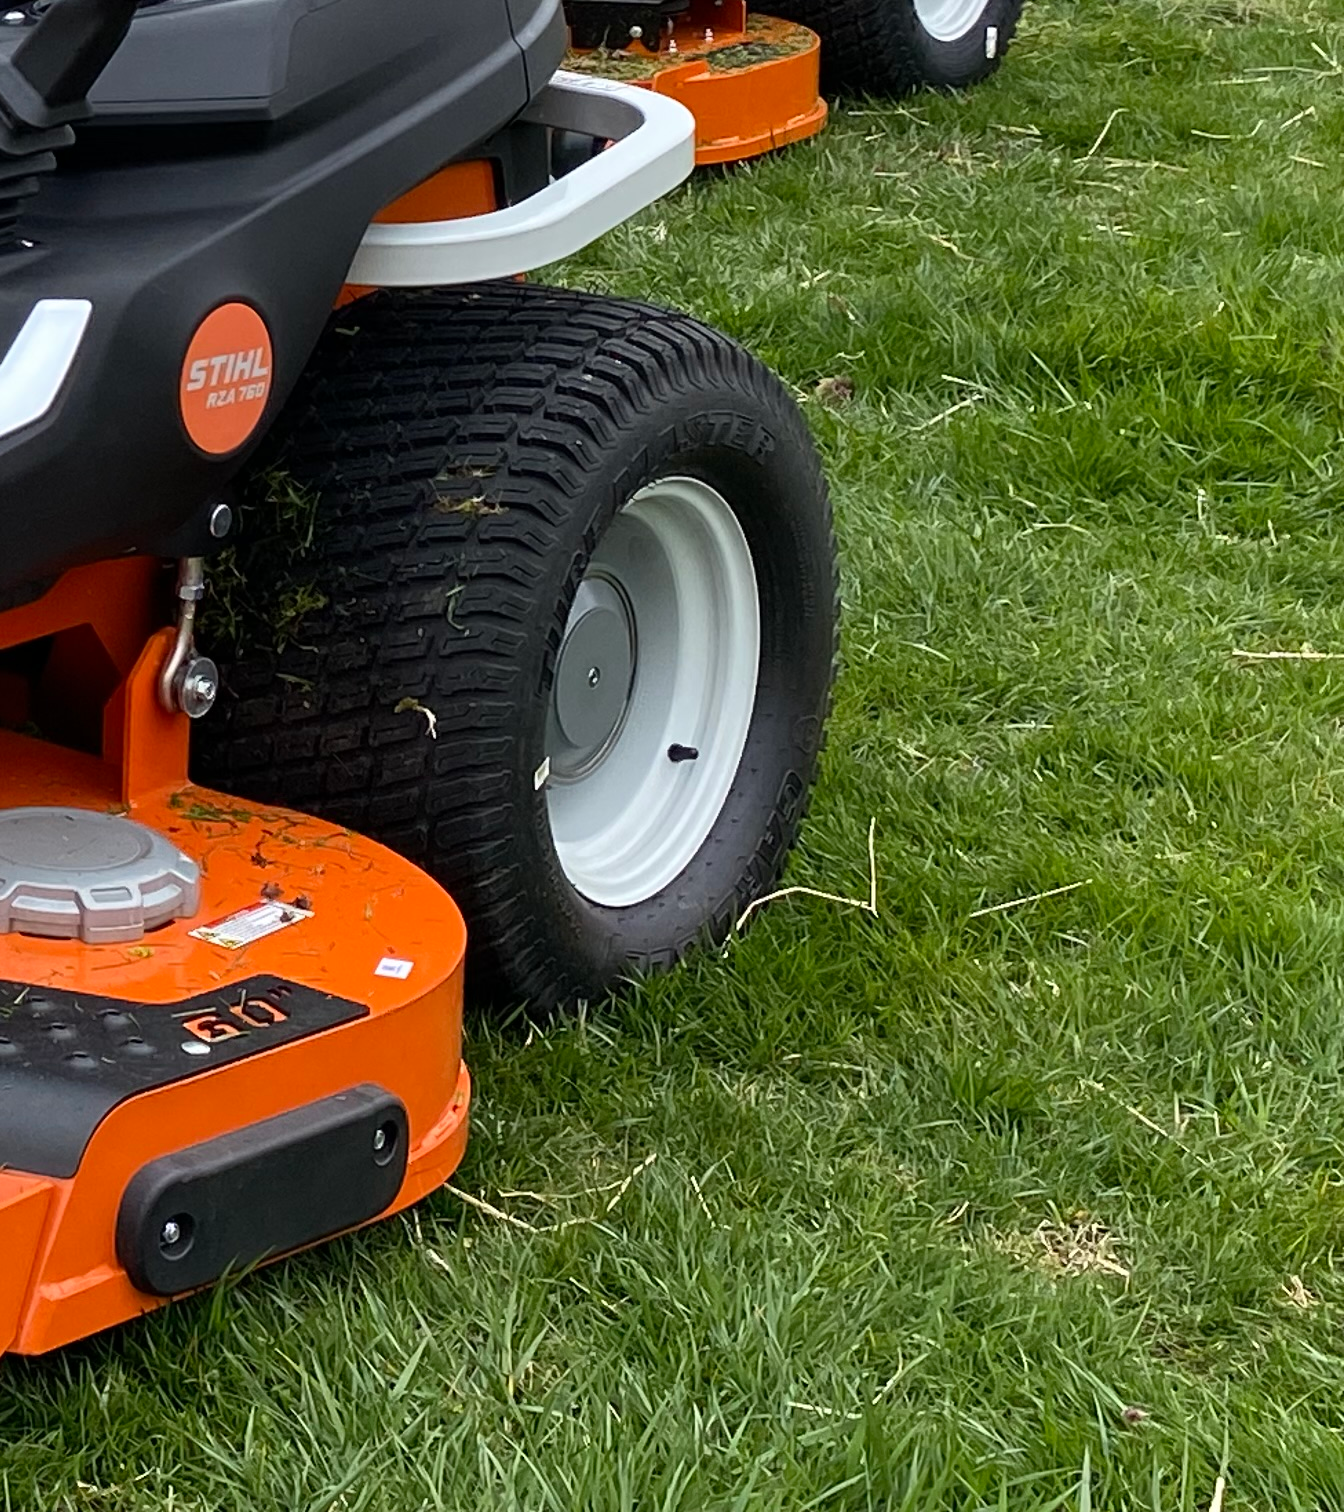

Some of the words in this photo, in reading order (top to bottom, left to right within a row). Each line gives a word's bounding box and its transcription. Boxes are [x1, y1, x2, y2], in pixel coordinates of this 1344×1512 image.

[186, 346, 269, 392] STIHL
[205, 387, 236, 410] RZA
[238, 381, 267, 403] 760
